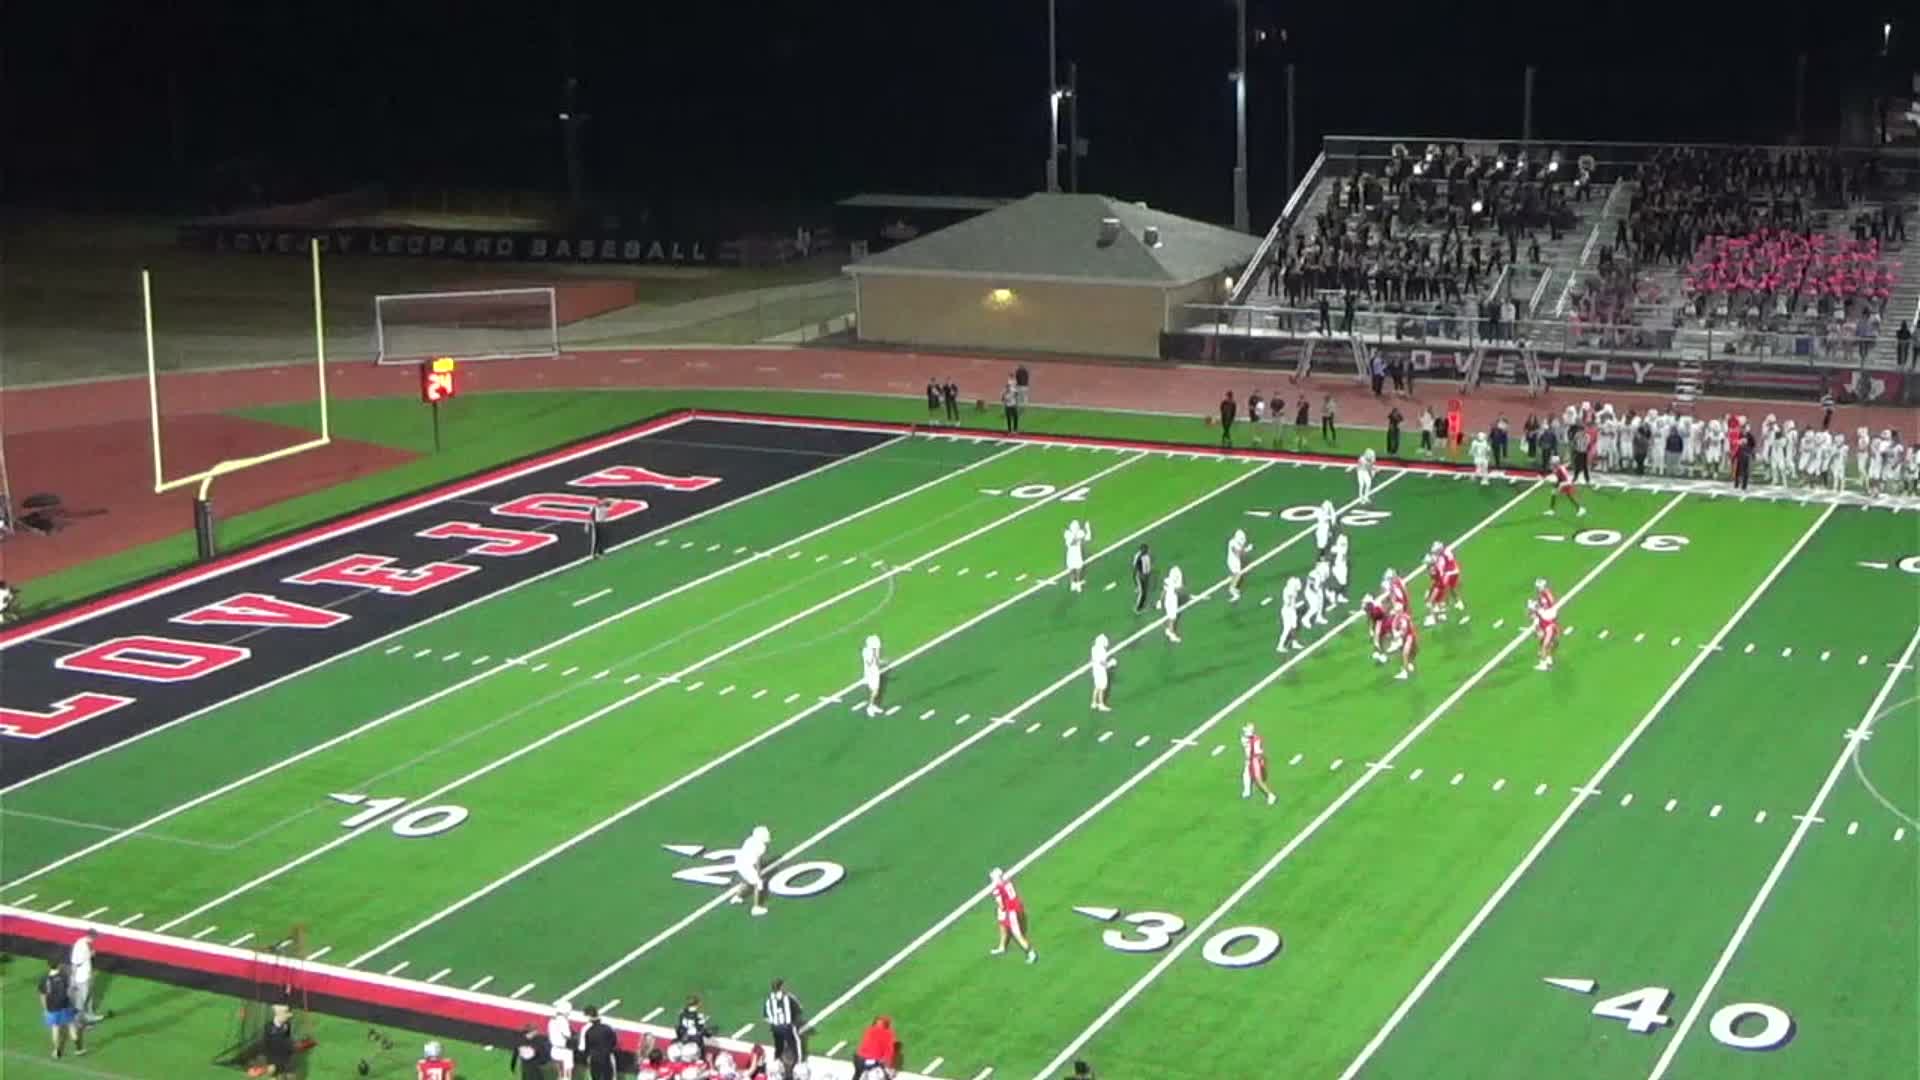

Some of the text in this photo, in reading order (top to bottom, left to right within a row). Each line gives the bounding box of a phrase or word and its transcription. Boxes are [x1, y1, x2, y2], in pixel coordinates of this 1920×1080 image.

[369, 232, 513, 256] LEOPARD
[531, 238, 706, 260] BASEBALL
[1366, 347, 1663, 384] OVEJOY
[1575, 529, 1690, 551] 30
[0, 465, 723, 739] LOVEJOY
[340, 797, 469, 837] 10
[1102, 911, 1282, 967] 30
[1591, 986, 1792, 1049] 40
